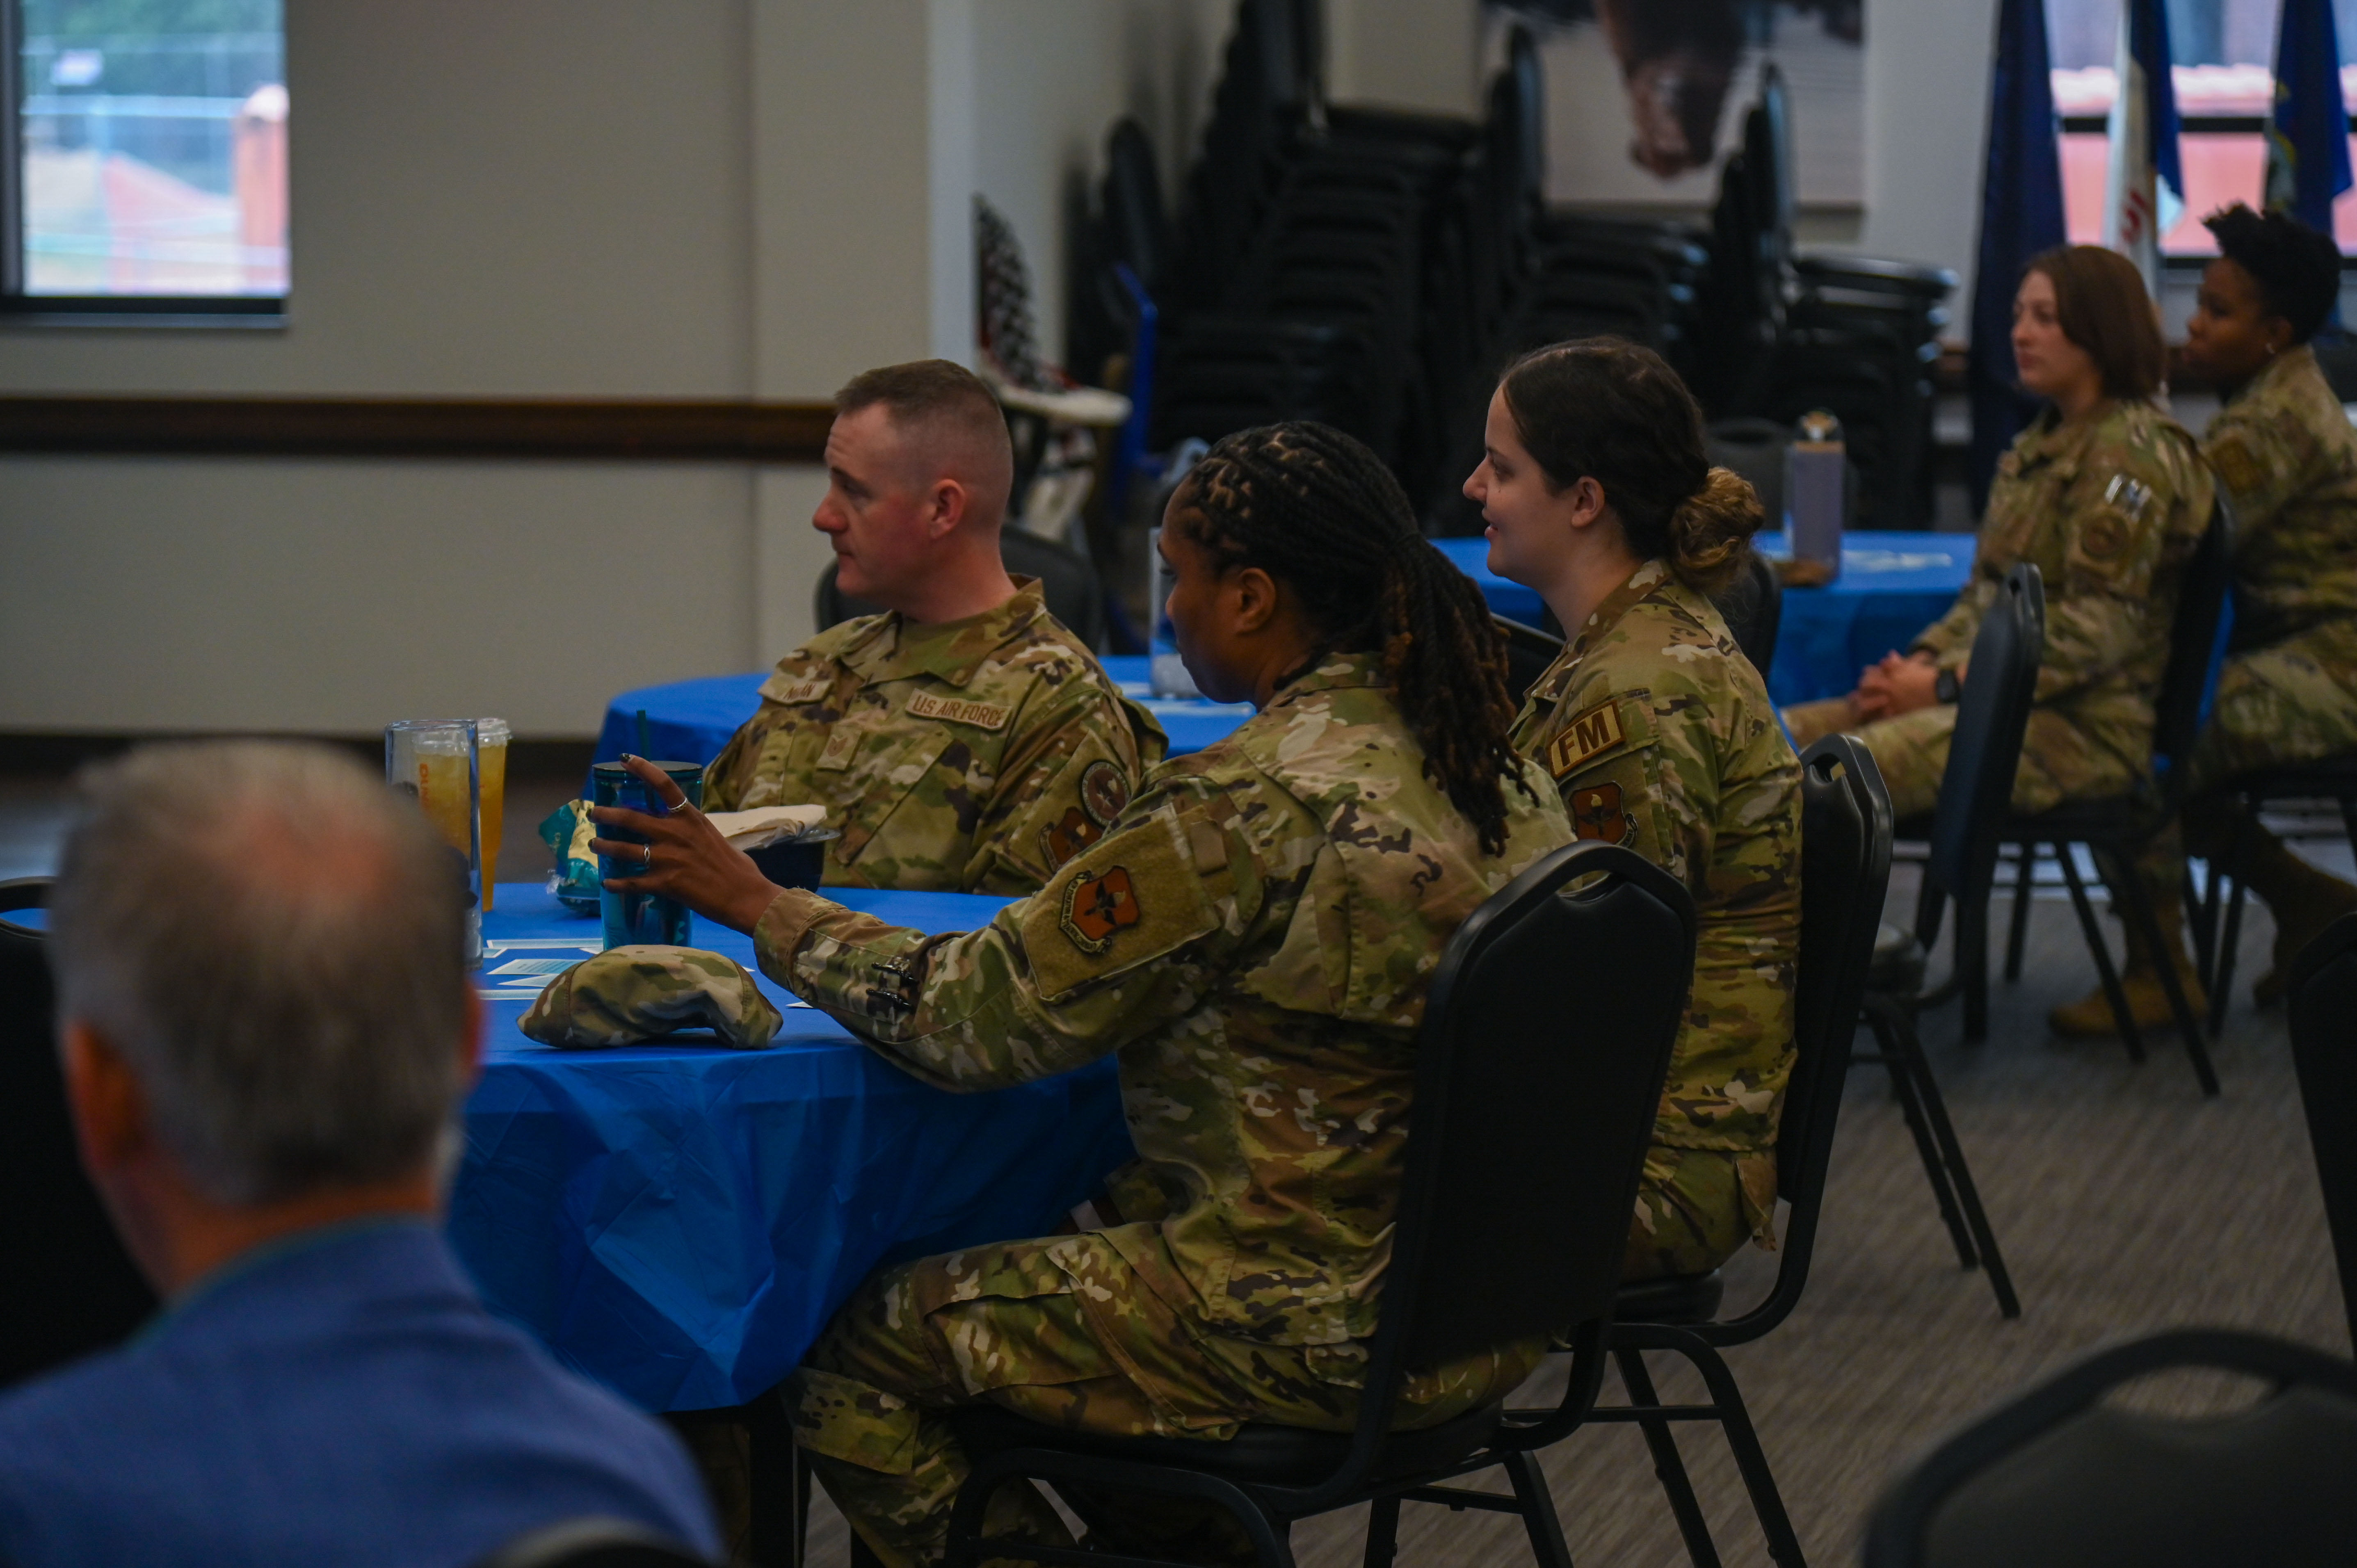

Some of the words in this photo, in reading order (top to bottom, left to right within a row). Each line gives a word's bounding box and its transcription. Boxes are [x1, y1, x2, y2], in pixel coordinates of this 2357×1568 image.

[936, 701, 962, 717] AIR
[960, 704, 1005, 726] FORCE
[1558, 710, 1611, 767] FM
